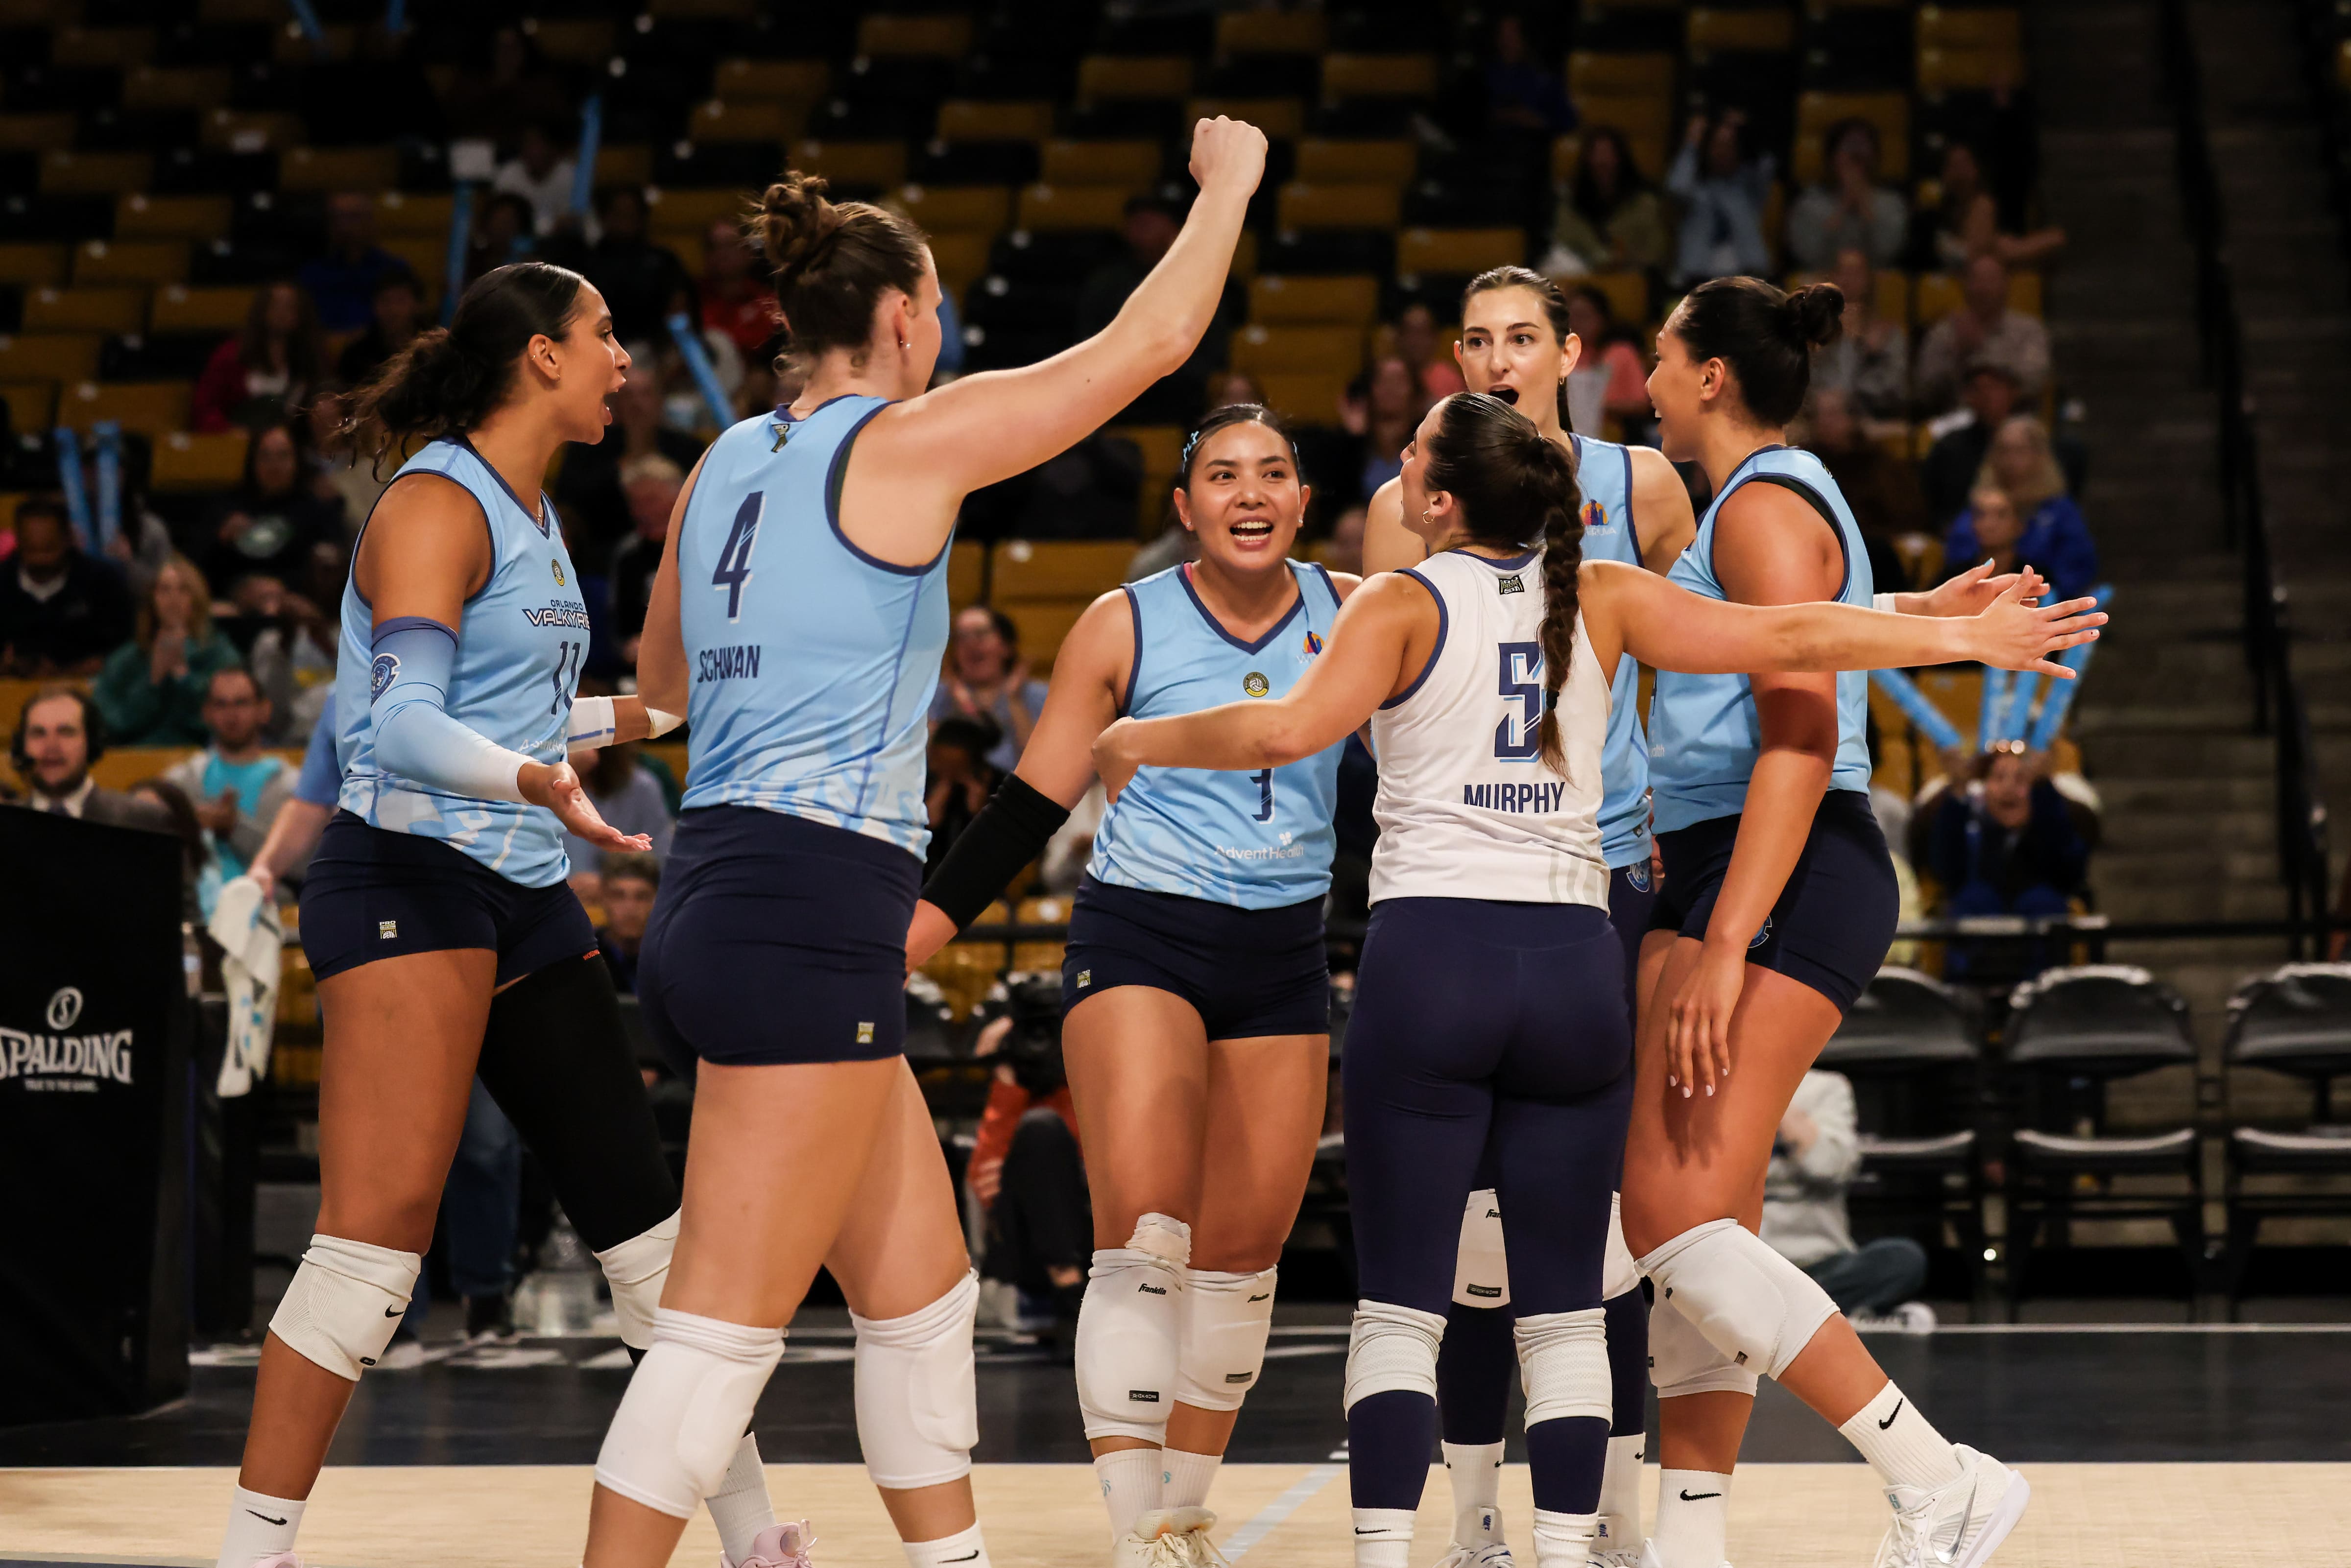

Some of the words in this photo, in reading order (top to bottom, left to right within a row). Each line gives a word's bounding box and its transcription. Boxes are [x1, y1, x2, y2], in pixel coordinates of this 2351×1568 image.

[712, 491, 766, 623] 4
[522, 608, 590, 630] VALKYRIE
[551, 599, 583, 611] ORLANDO
[551, 641, 581, 717] 11
[697, 645, 760, 683] SCHWAN
[1494, 641, 1545, 762] 5
[1463, 782, 1565, 812] MURPHY
[1214, 843, 1304, 859] AdventHealth
[1138, 1283, 1166, 1295] Franklin
